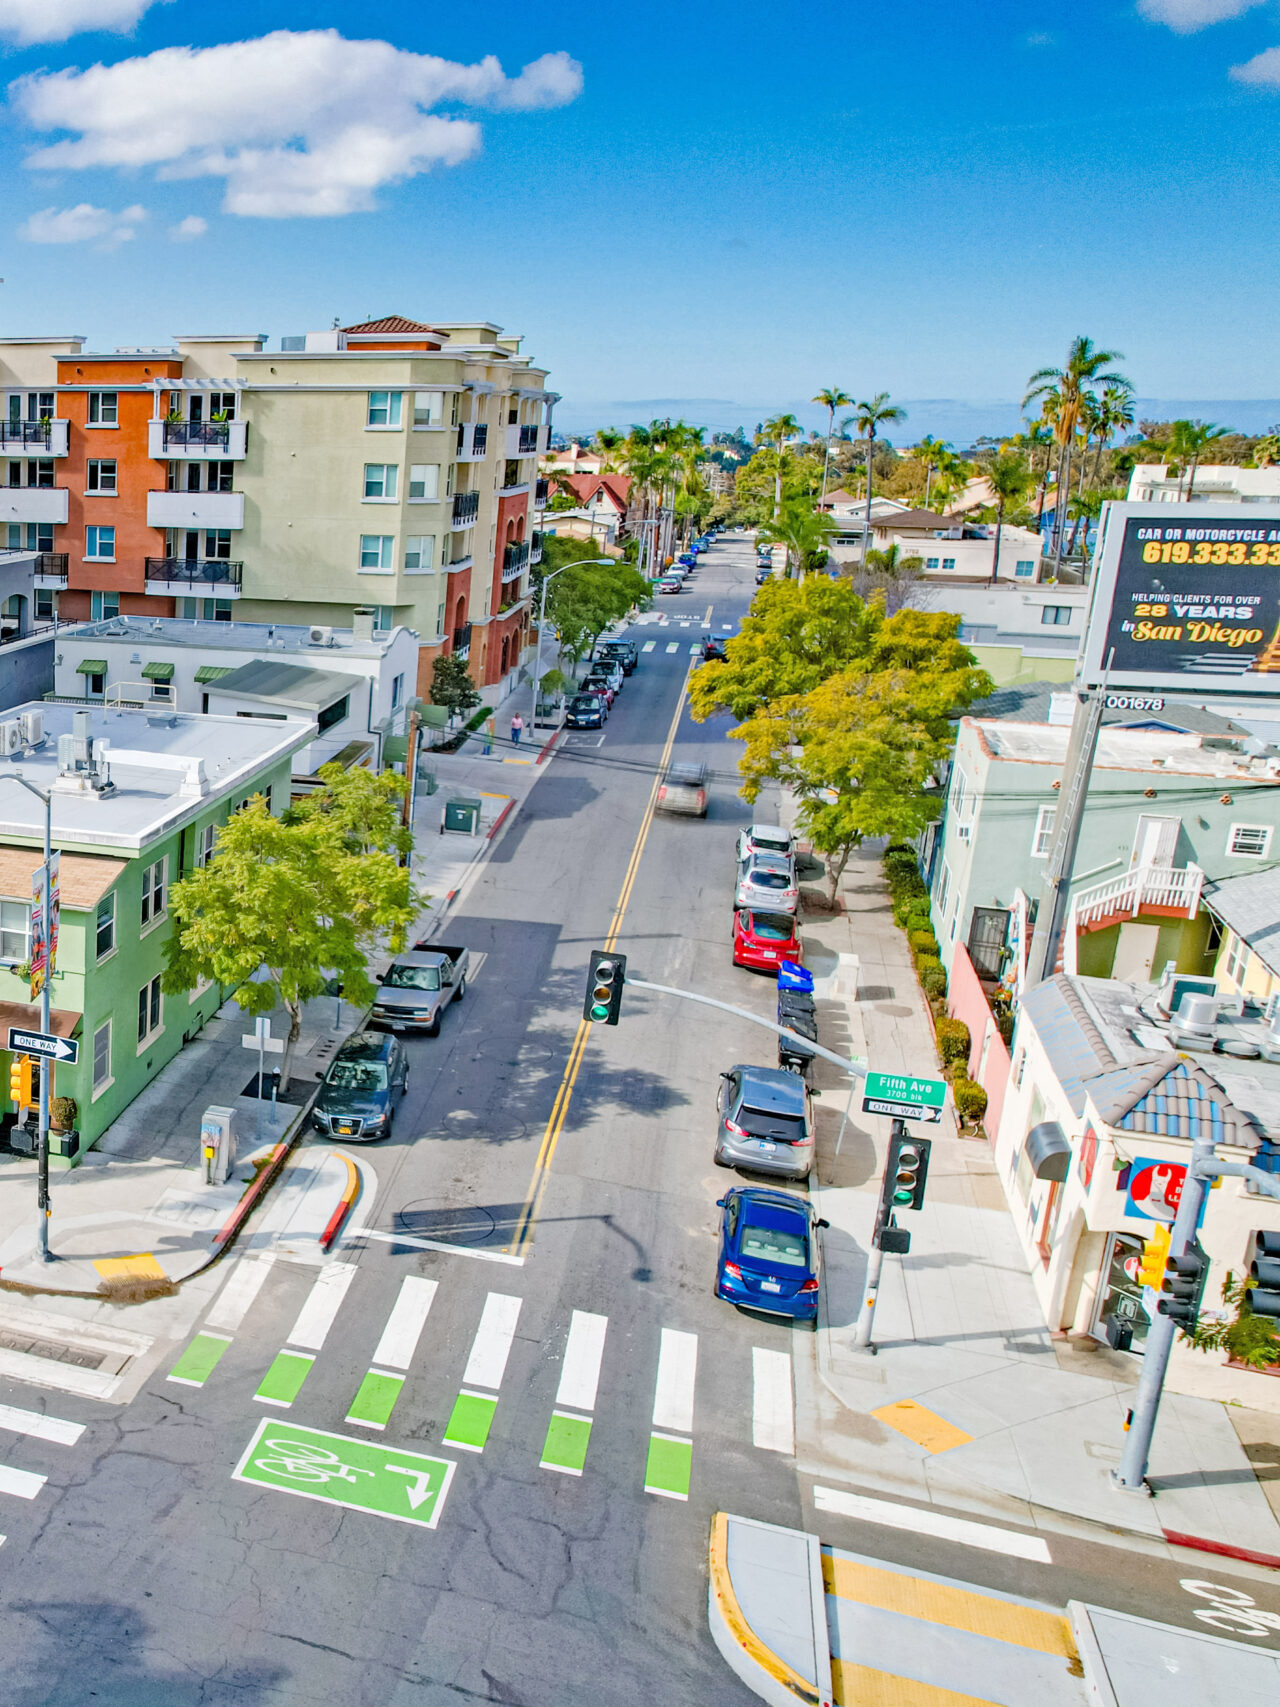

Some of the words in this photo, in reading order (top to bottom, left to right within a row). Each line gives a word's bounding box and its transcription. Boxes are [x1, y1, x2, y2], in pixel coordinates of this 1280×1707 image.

[1138, 528, 1162, 540] CAR
[1165, 528, 1182, 540] OR
[1185, 529, 1266, 541] MOTORCYCLE
[1132, 593, 1170, 602] HELPING
[1173, 594, 1211, 604] CLIENTS
[1214, 595, 1232, 604] FOR
[1236, 596, 1261, 605] OVER
[1134, 604, 1168, 617] 28
[1173, 605, 1253, 619] YEARS
[1121, 620, 1136, 632] in
[1131, 621, 1182, 642] San
[1187, 621, 1263, 648] Diego
[19, 1037, 36, 1047] ONE
[39, 1041, 57, 1051] WAY
[880, 1076, 906, 1090] Fifth
[910, 1081, 932, 1093] Ave
[886, 1090, 907, 1099] 3700
[910, 1093, 922, 1101] blk
[873, 1103, 896, 1113] ONE
[900, 1107, 924, 1117] WAY
